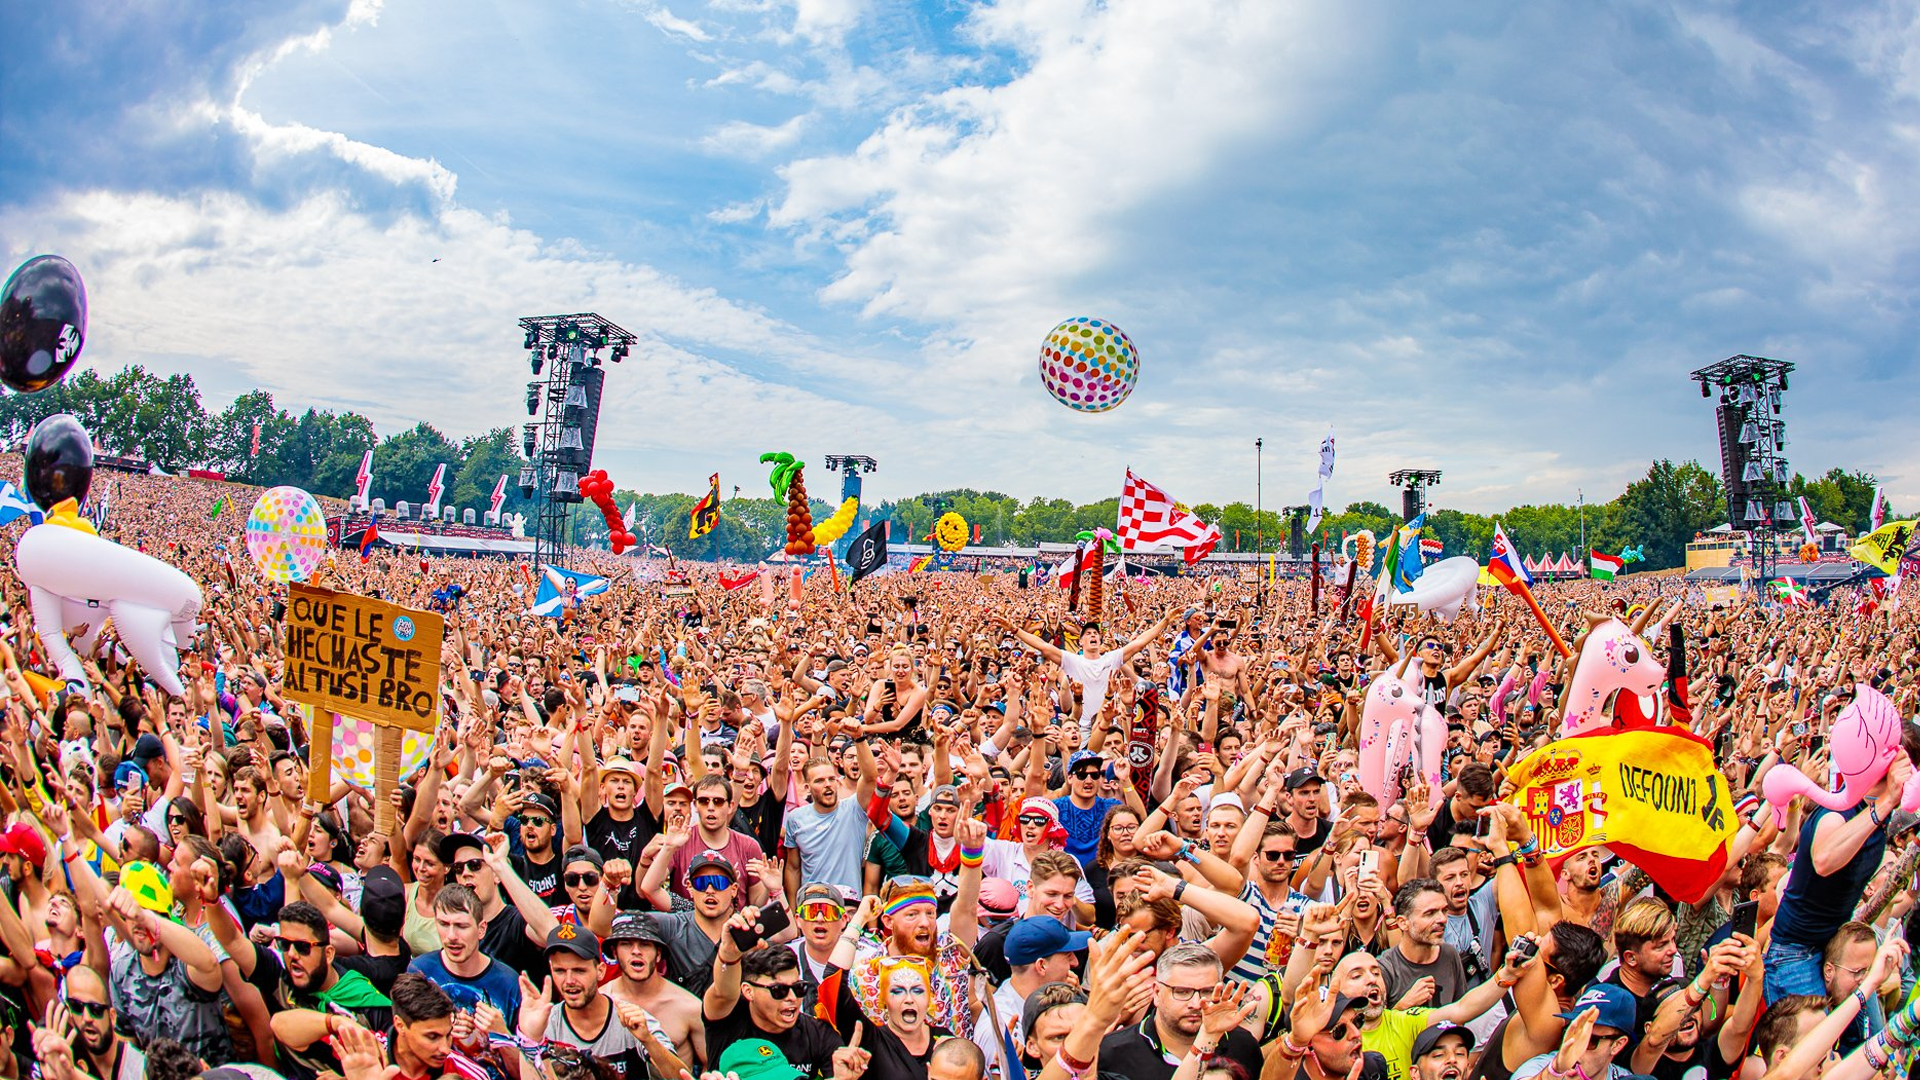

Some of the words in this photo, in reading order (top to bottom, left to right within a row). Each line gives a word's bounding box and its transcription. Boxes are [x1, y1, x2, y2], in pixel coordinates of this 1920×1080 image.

[293, 597, 347, 633] QUE
[355, 608, 383, 643] LE
[287, 625, 423, 683] HECHASTE
[378, 678, 433, 718] BRO
